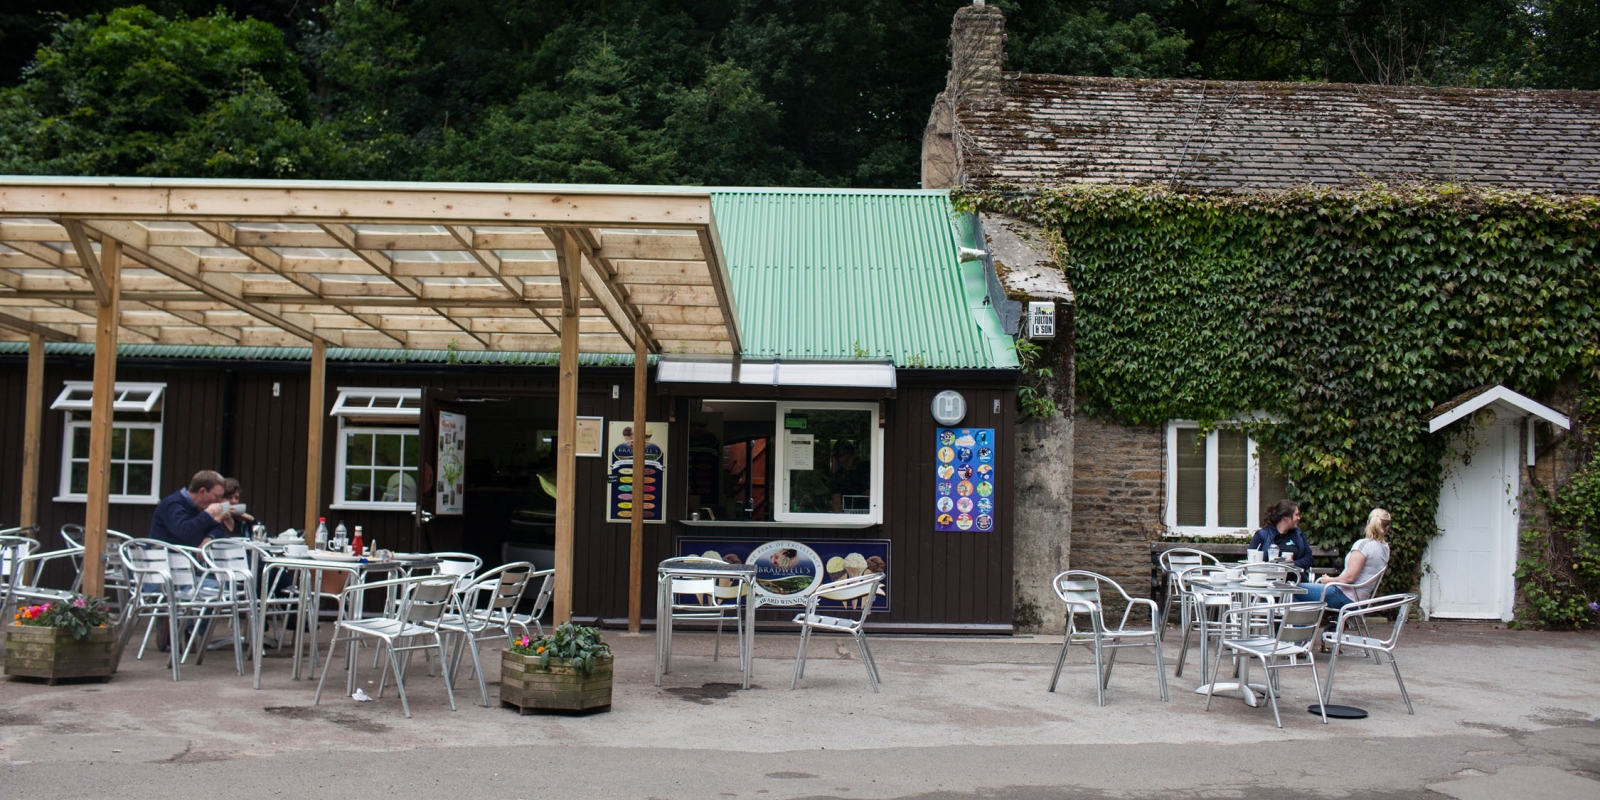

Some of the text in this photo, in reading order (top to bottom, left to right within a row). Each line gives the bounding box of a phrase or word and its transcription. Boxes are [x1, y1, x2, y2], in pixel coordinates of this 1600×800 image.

[1035, 316, 1052, 324] FULTON
[1036, 325, 1052, 333] & SON
[758, 545, 773, 554] PEAK
[788, 543, 821, 567] EXCELLENCE
